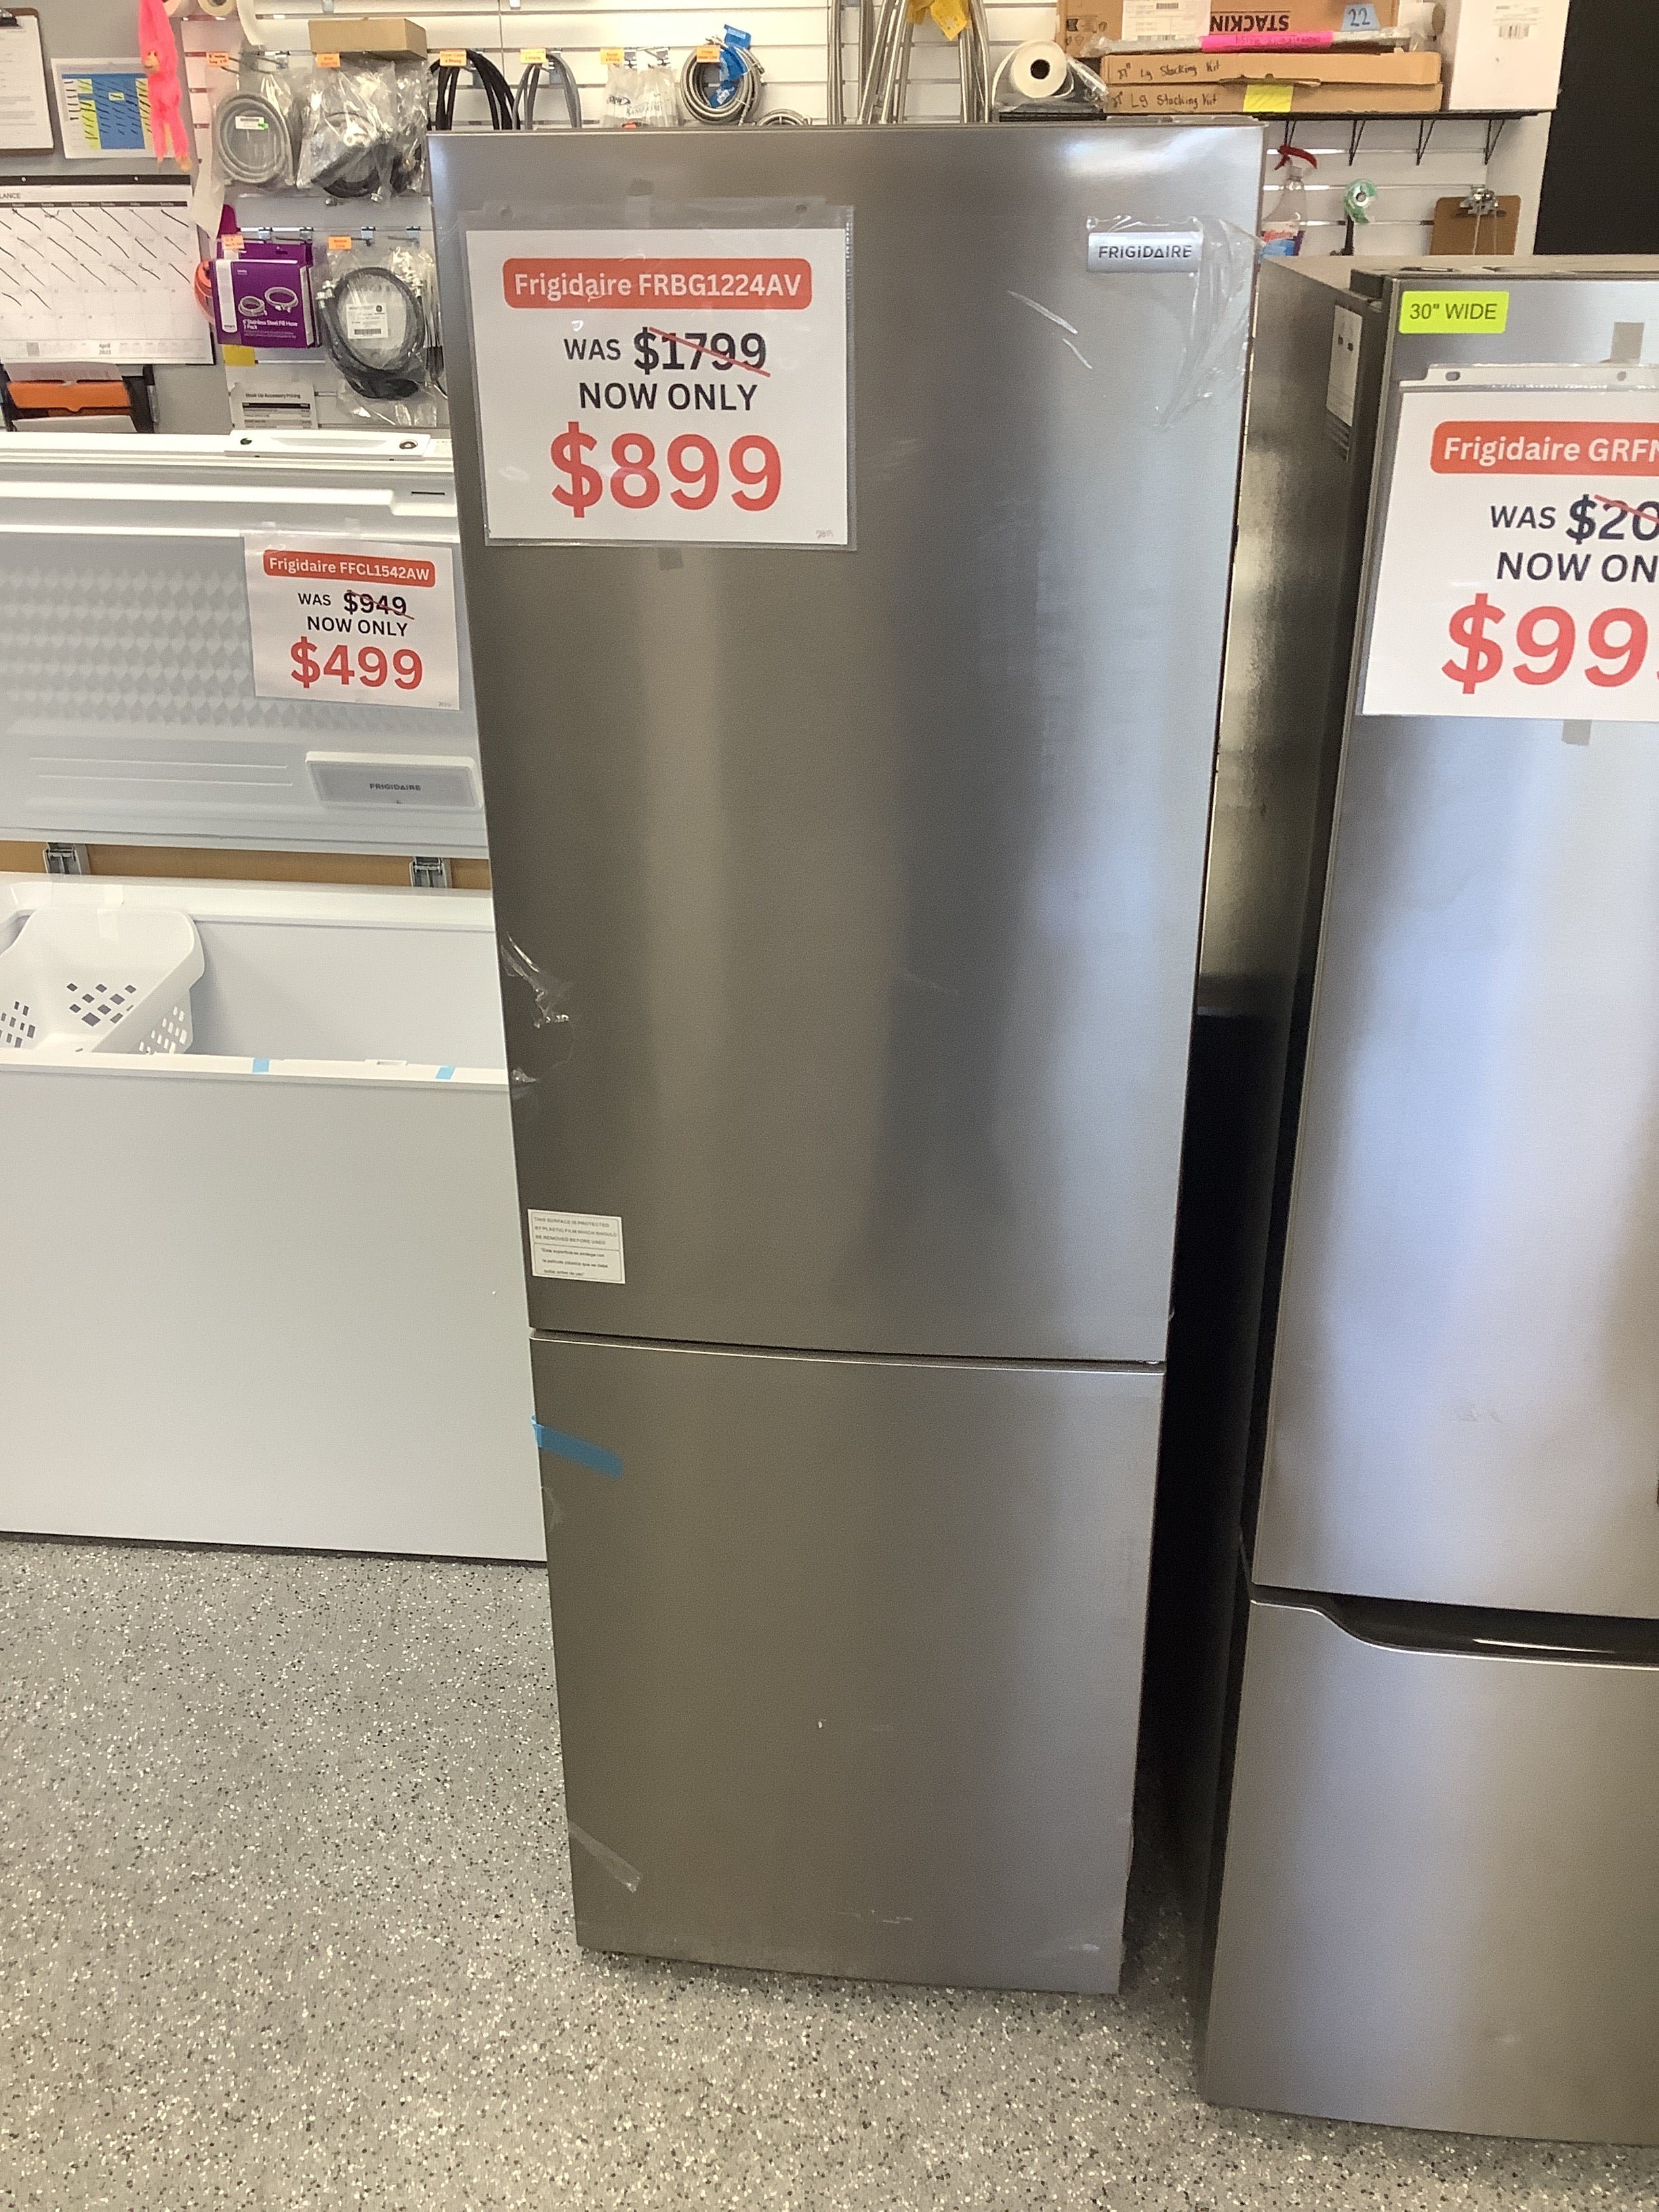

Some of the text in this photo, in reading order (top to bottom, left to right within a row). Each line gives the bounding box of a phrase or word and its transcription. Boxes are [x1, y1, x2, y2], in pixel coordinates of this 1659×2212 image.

[1348, 7, 1371, 26] 22
[1160, 64, 1197, 79] Stacking
[1206, 59, 1220, 72] Kit
[1131, 94, 1148, 108] Lg
[1157, 94, 1198, 108] Stacking
[1202, 94, 1217, 105] Kit
[1098, 245, 1192, 258] FRIGIDAIRE
[514, 272, 801, 302] Frigidaire FRBG1224AV
[1410, 303, 1498, 320] 30" WIDE
[563, 327, 767, 375] WAS $1799
[579, 382, 758, 411] NOW ONLY
[1443, 436, 1580, 467] Frigidaire
[550, 422, 781, 518] $899
[1490, 493, 1659, 545] WAS $20
[269, 557, 430, 581] Frigidaire FFCL1542AW
[1497, 552, 1658, 583] NOW ON
[298, 591, 407, 616] WAS $949
[307, 616, 408, 636] NOW ONLY
[1441, 593, 1659, 695] $99
[290, 636, 424, 690] $499
